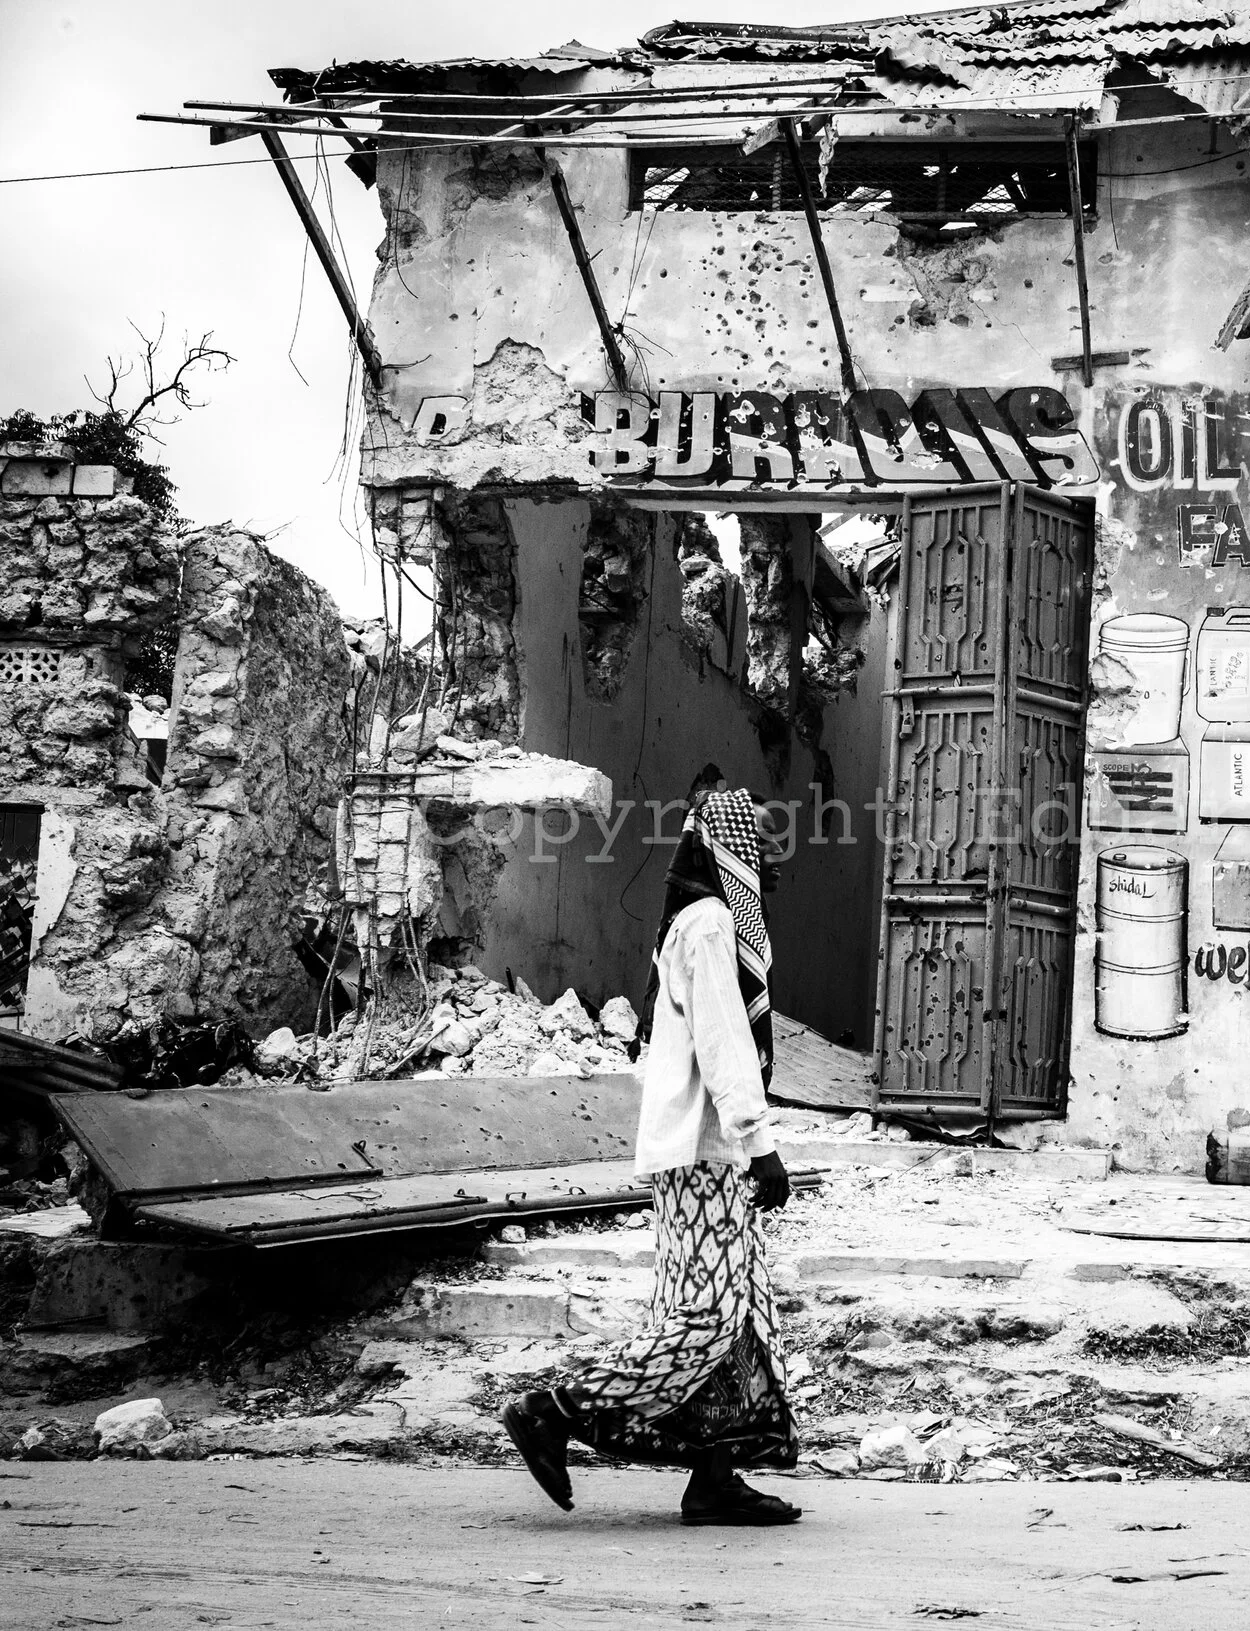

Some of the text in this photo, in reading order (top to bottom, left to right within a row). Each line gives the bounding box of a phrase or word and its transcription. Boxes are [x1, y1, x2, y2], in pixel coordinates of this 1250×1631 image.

[1122, 400, 1243, 486] OIL
[1103, 763, 1129, 772] SCOPE
[1233, 753, 1243, 797] ATLANTIC
